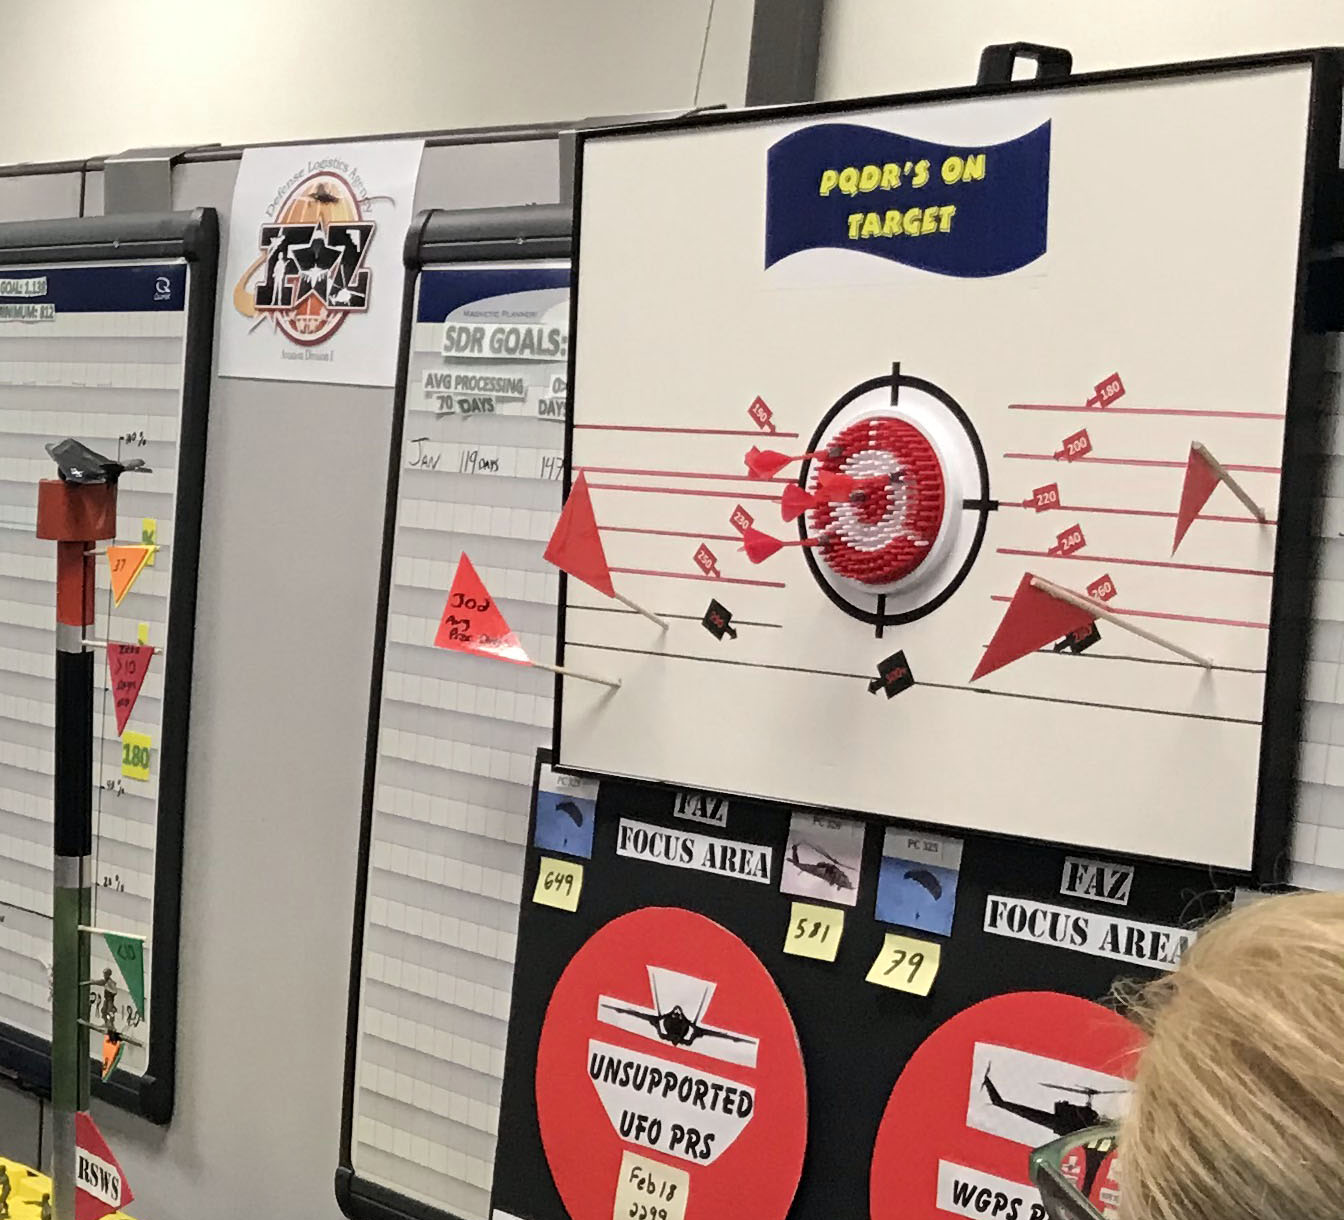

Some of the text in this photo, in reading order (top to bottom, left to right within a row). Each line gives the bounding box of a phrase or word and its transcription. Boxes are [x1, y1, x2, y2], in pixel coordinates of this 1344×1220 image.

[265, 168, 305, 218] Defense
[307, 157, 350, 173] Logistics
[819, 154, 986, 197] PQDR'S ON
[848, 205, 956, 240] TARGET
[444, 325, 486, 354] SDR
[425, 372, 523, 394] AVG PROCESSING
[1100, 380, 1121, 400] 180
[438, 396, 495, 414] 70 DAYS
[751, 403, 768, 422] 190
[1066, 436, 1088, 456] 200
[1036, 490, 1057, 506] 220
[733, 511, 750, 530] 230
[1060, 531, 1081, 550] 240
[697, 551, 713, 569] 250
[1092, 581, 1112, 600] 260
[122, 742, 151, 769] 180
[619, 824, 769, 880] FOCUS AREA
[543, 871, 575, 896] 649
[1065, 862, 1131, 902] FAZ
[987, 899, 1189, 965] FOCUS AREA
[883, 949, 925, 984] 79
[589, 1053, 754, 1118] UNSUPPORTED
[619, 1110, 715, 1160] UFO PRS
[78, 1155, 119, 1201] RSWS
[629, 1166, 677, 1201] Feb 18
